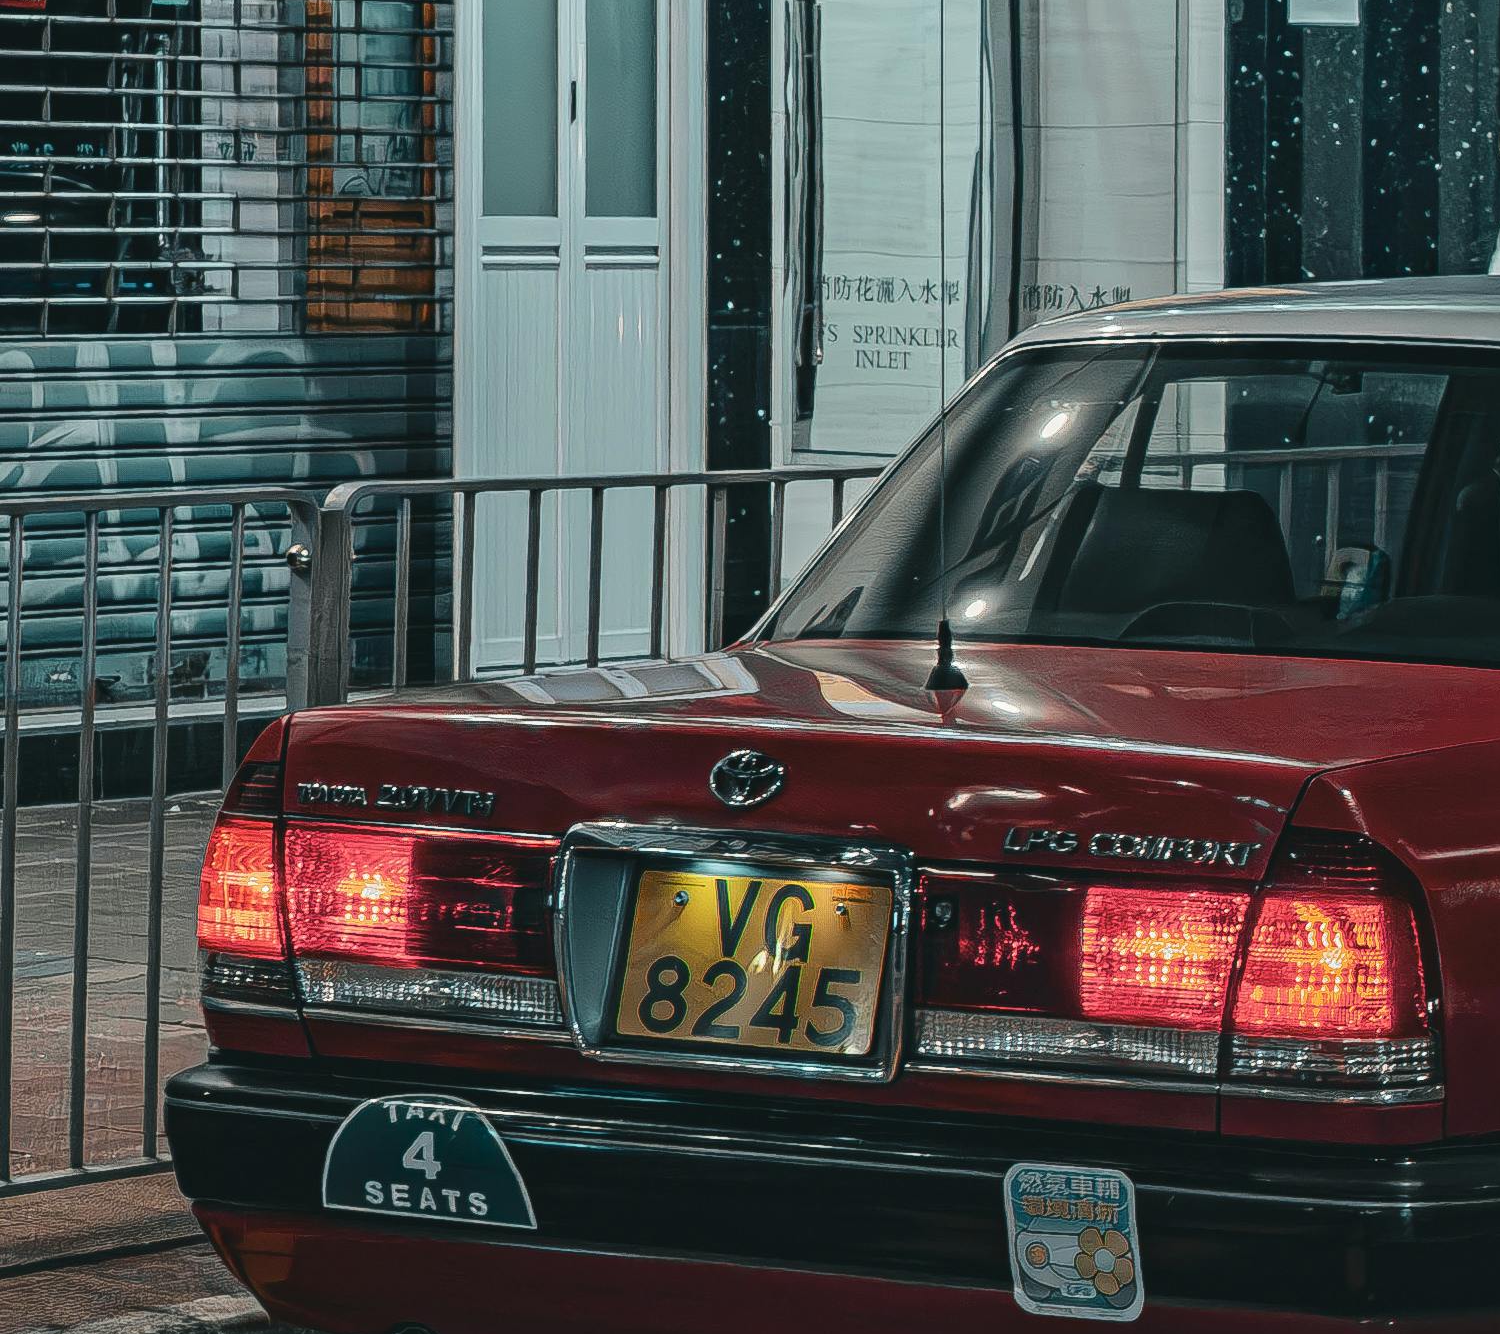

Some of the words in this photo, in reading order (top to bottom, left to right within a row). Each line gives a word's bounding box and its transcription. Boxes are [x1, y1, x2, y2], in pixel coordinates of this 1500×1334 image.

[852, 324, 961, 349] SPRINKLER
[855, 350, 911, 370] INLET
[297, 781, 368, 807] TOYOTA
[1004, 824, 1080, 855] LPG
[1088, 831, 1263, 868] COMFORT
[713, 877, 817, 961] VG
[637, 954, 862, 1049] 8245
[382, 1098, 467, 1131] TAXI
[401, 1131, 442, 1181] 4
[362, 1177, 491, 1218] SEATS
